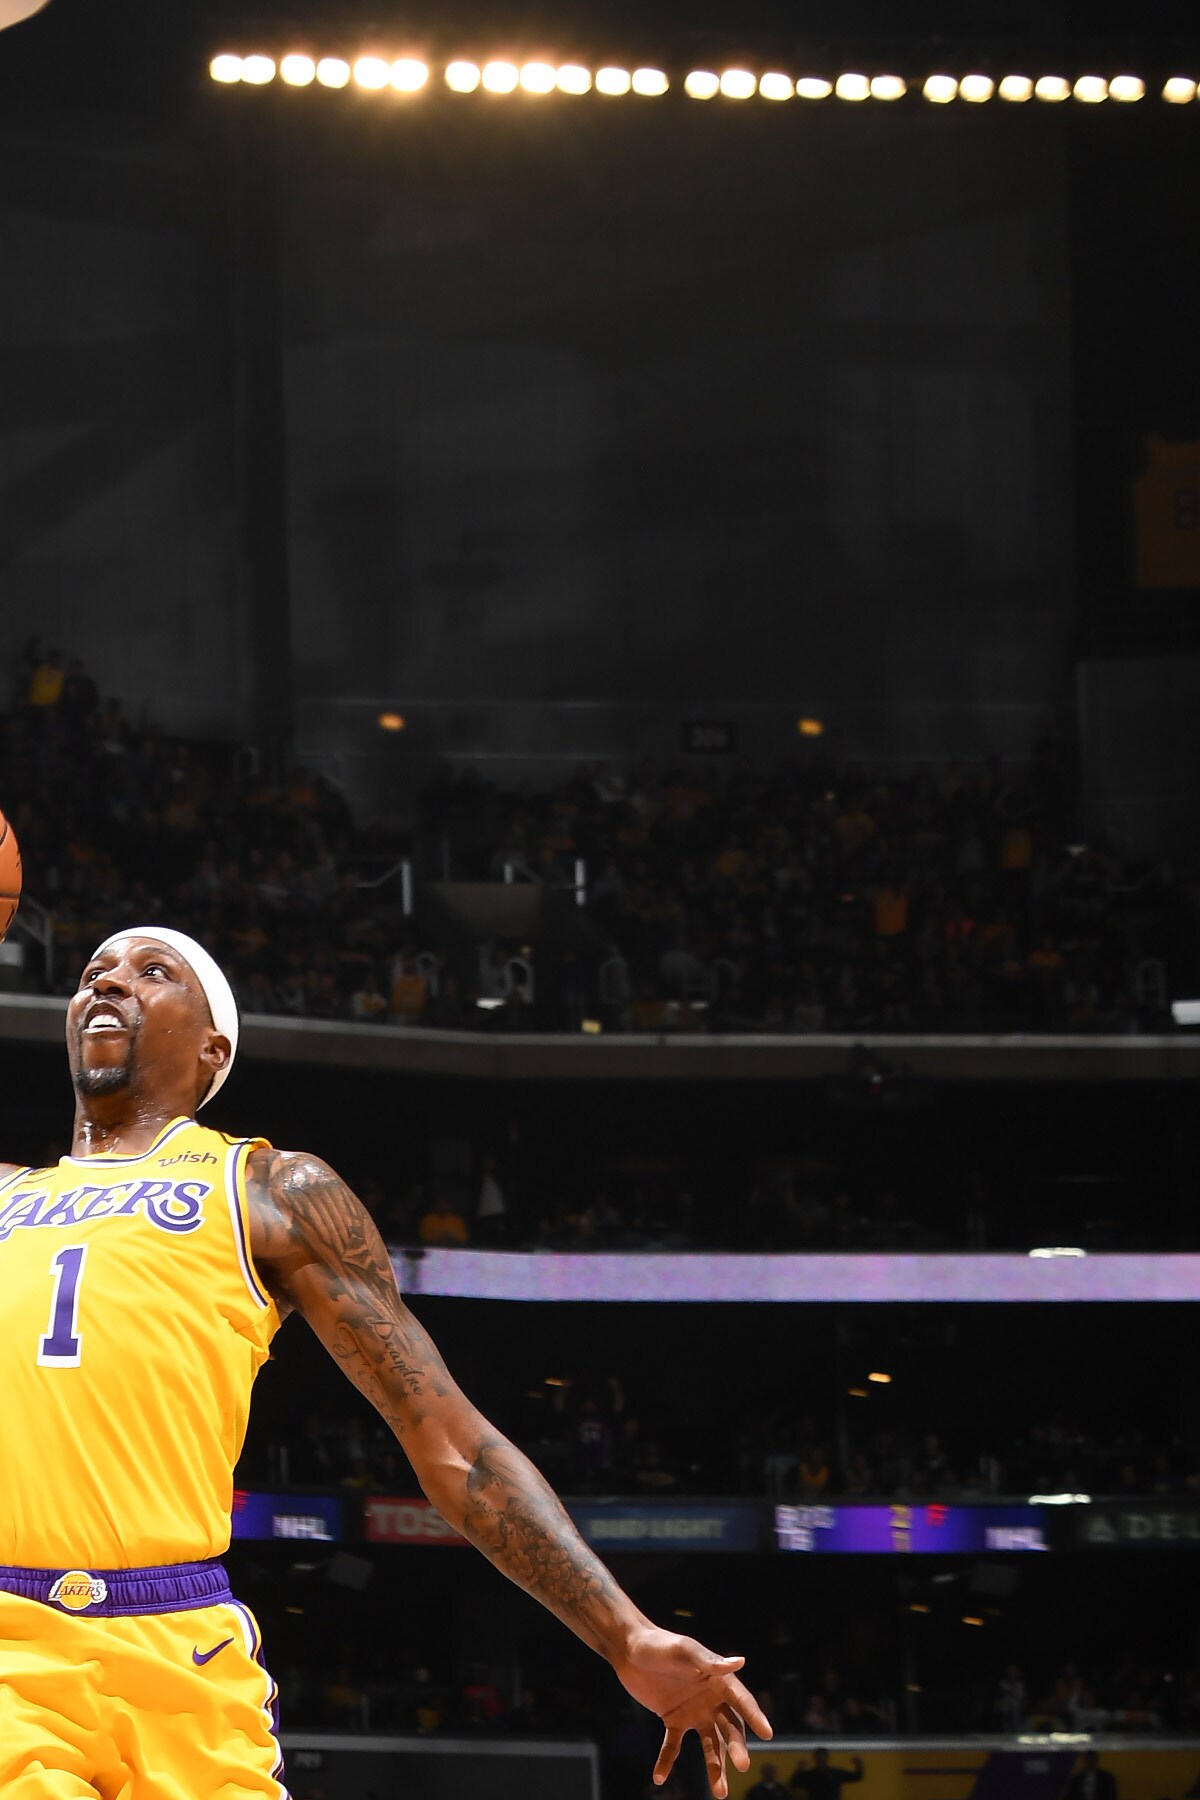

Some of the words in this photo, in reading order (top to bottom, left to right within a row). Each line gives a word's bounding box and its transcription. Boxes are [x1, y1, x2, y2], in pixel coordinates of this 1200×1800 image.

[158, 1150, 218, 1168] wish
[36, 1243, 88, 1368] 1
[272, 1513, 334, 1541] NHL
[588, 1519, 650, 1538] BUD
[655, 1519, 727, 1538] LIGHT
[50, 1581, 104, 1601] LAKERS
